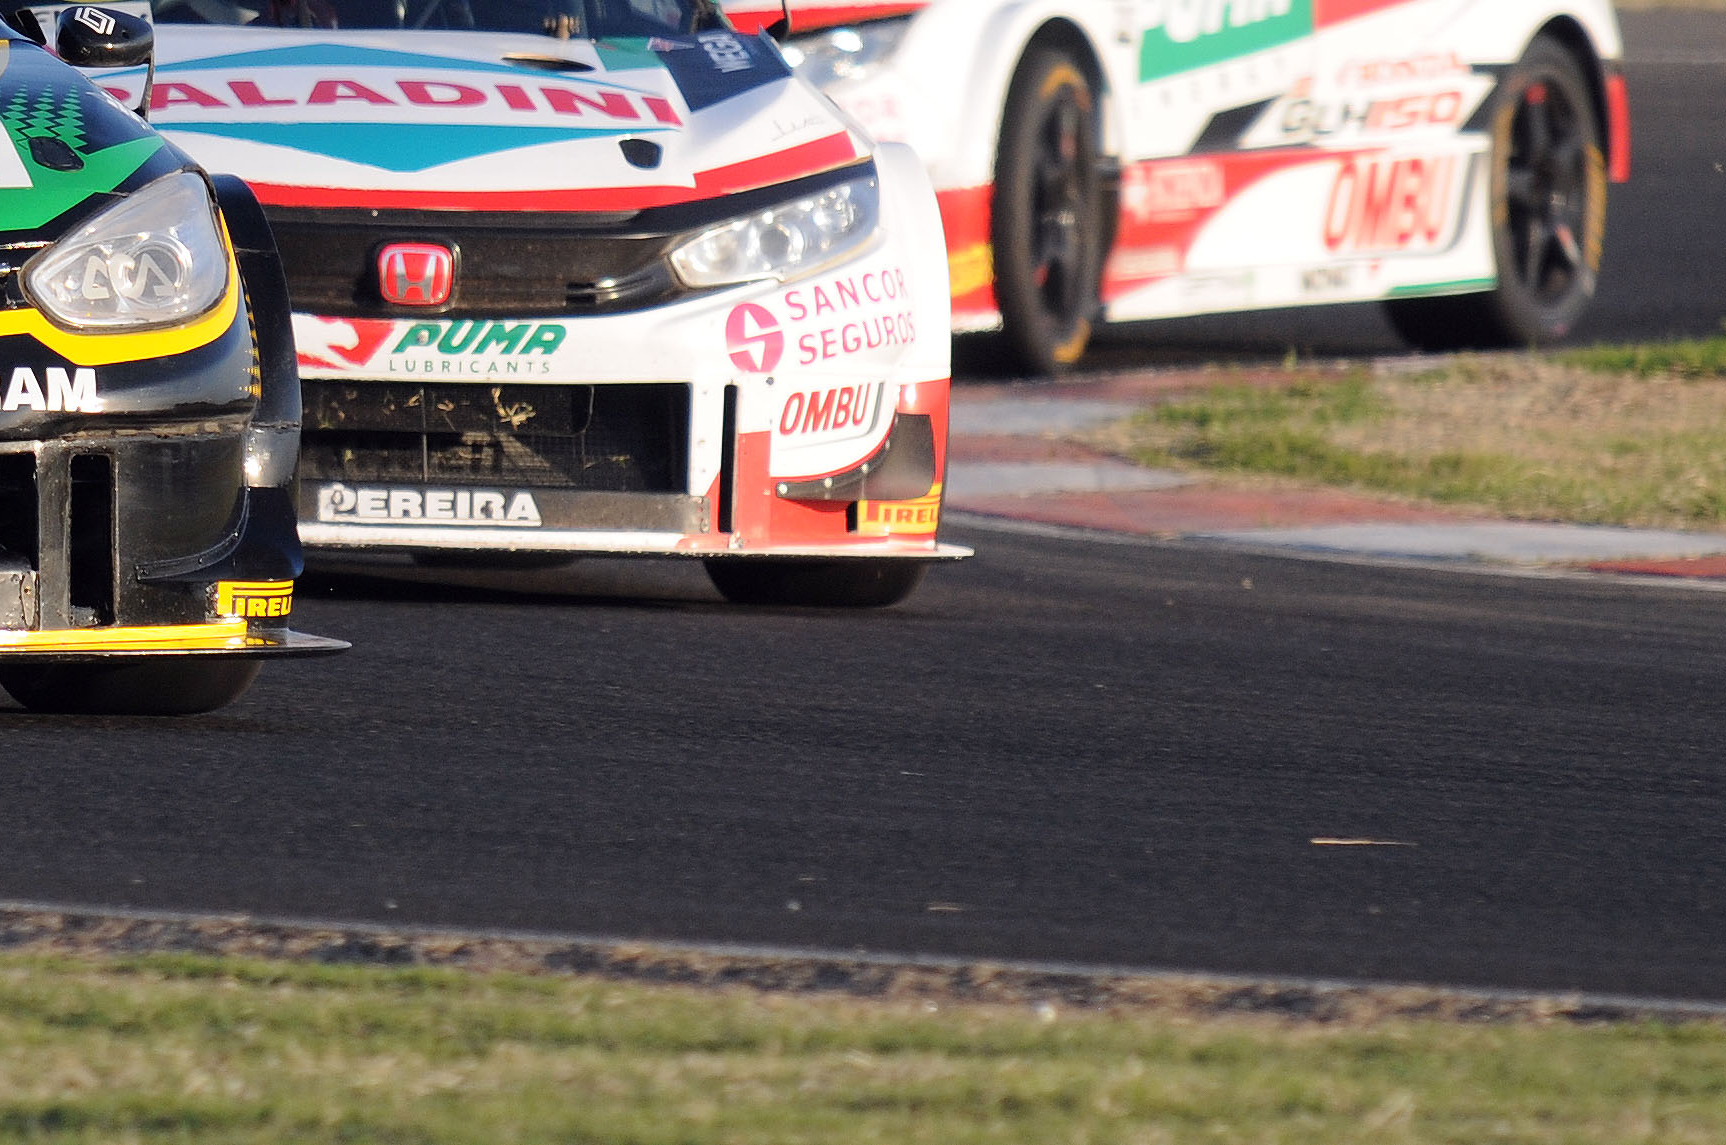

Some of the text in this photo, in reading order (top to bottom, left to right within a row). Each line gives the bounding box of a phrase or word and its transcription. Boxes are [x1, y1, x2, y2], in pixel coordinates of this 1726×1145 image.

[1324, 156, 1454, 252] OMBU
[784, 267, 909, 321] SANCOR
[392, 319, 566, 355] PUMA
[798, 312, 916, 366] SEGUROS
[389, 359, 550, 374] LUBRICANTS
[778, 383, 872, 436] OMBU
[319, 484, 541, 521] PEREIRA
